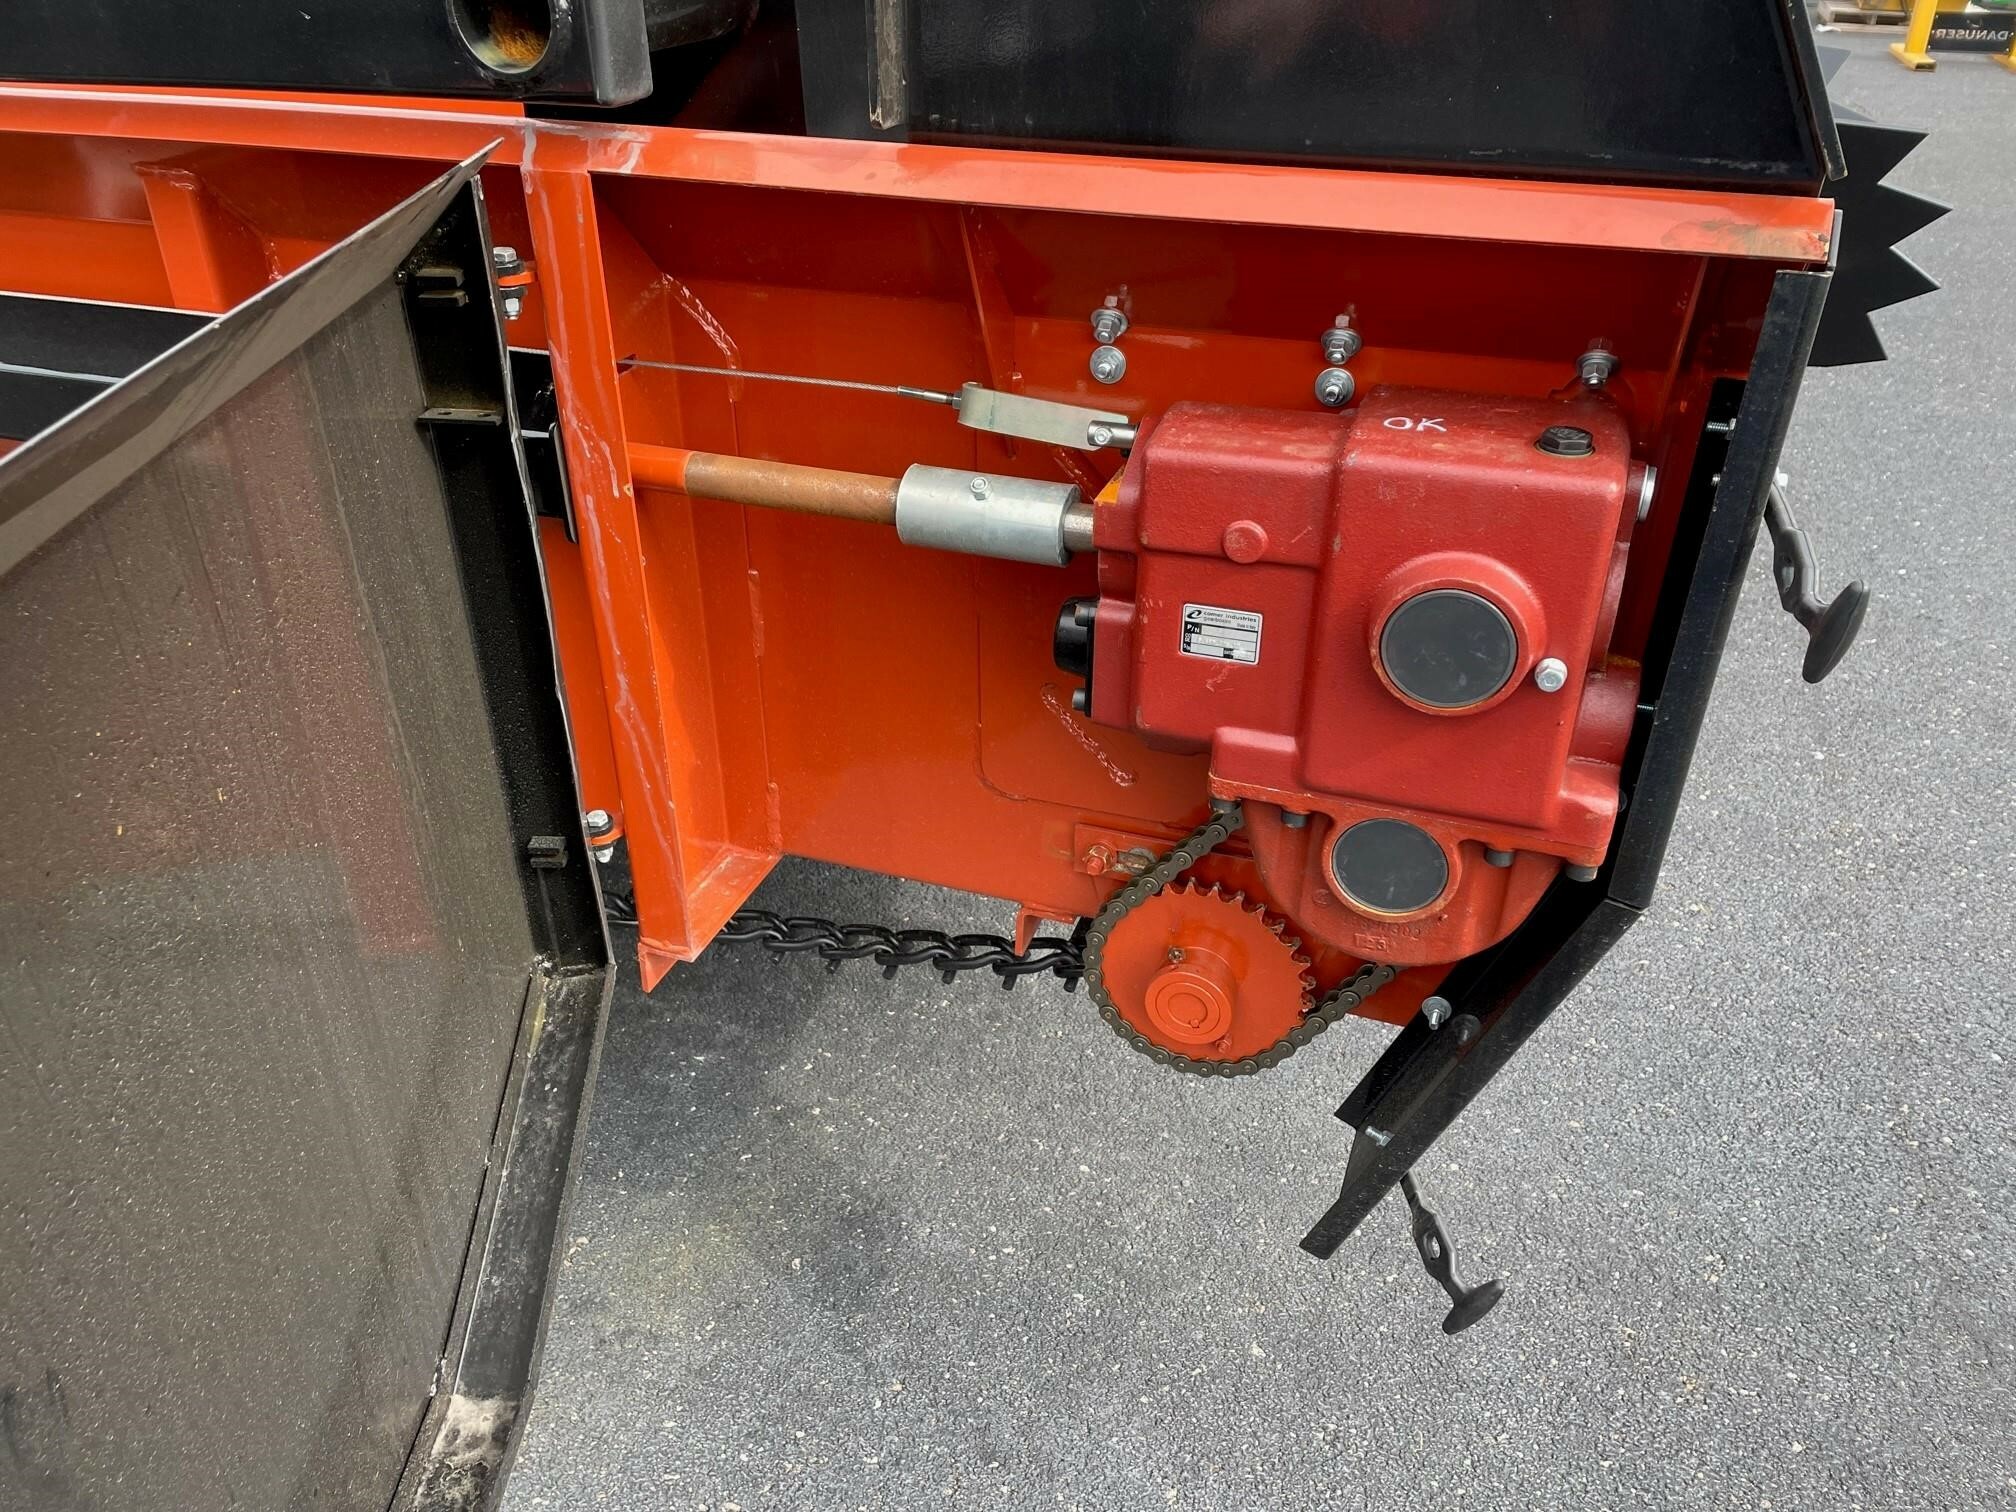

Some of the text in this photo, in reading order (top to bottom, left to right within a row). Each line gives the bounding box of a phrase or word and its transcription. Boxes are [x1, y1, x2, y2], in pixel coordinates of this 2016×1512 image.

[1383, 416, 1447, 432] OK
[1225, 613, 1257, 623] industries
[1187, 624, 1200, 633] P/N
